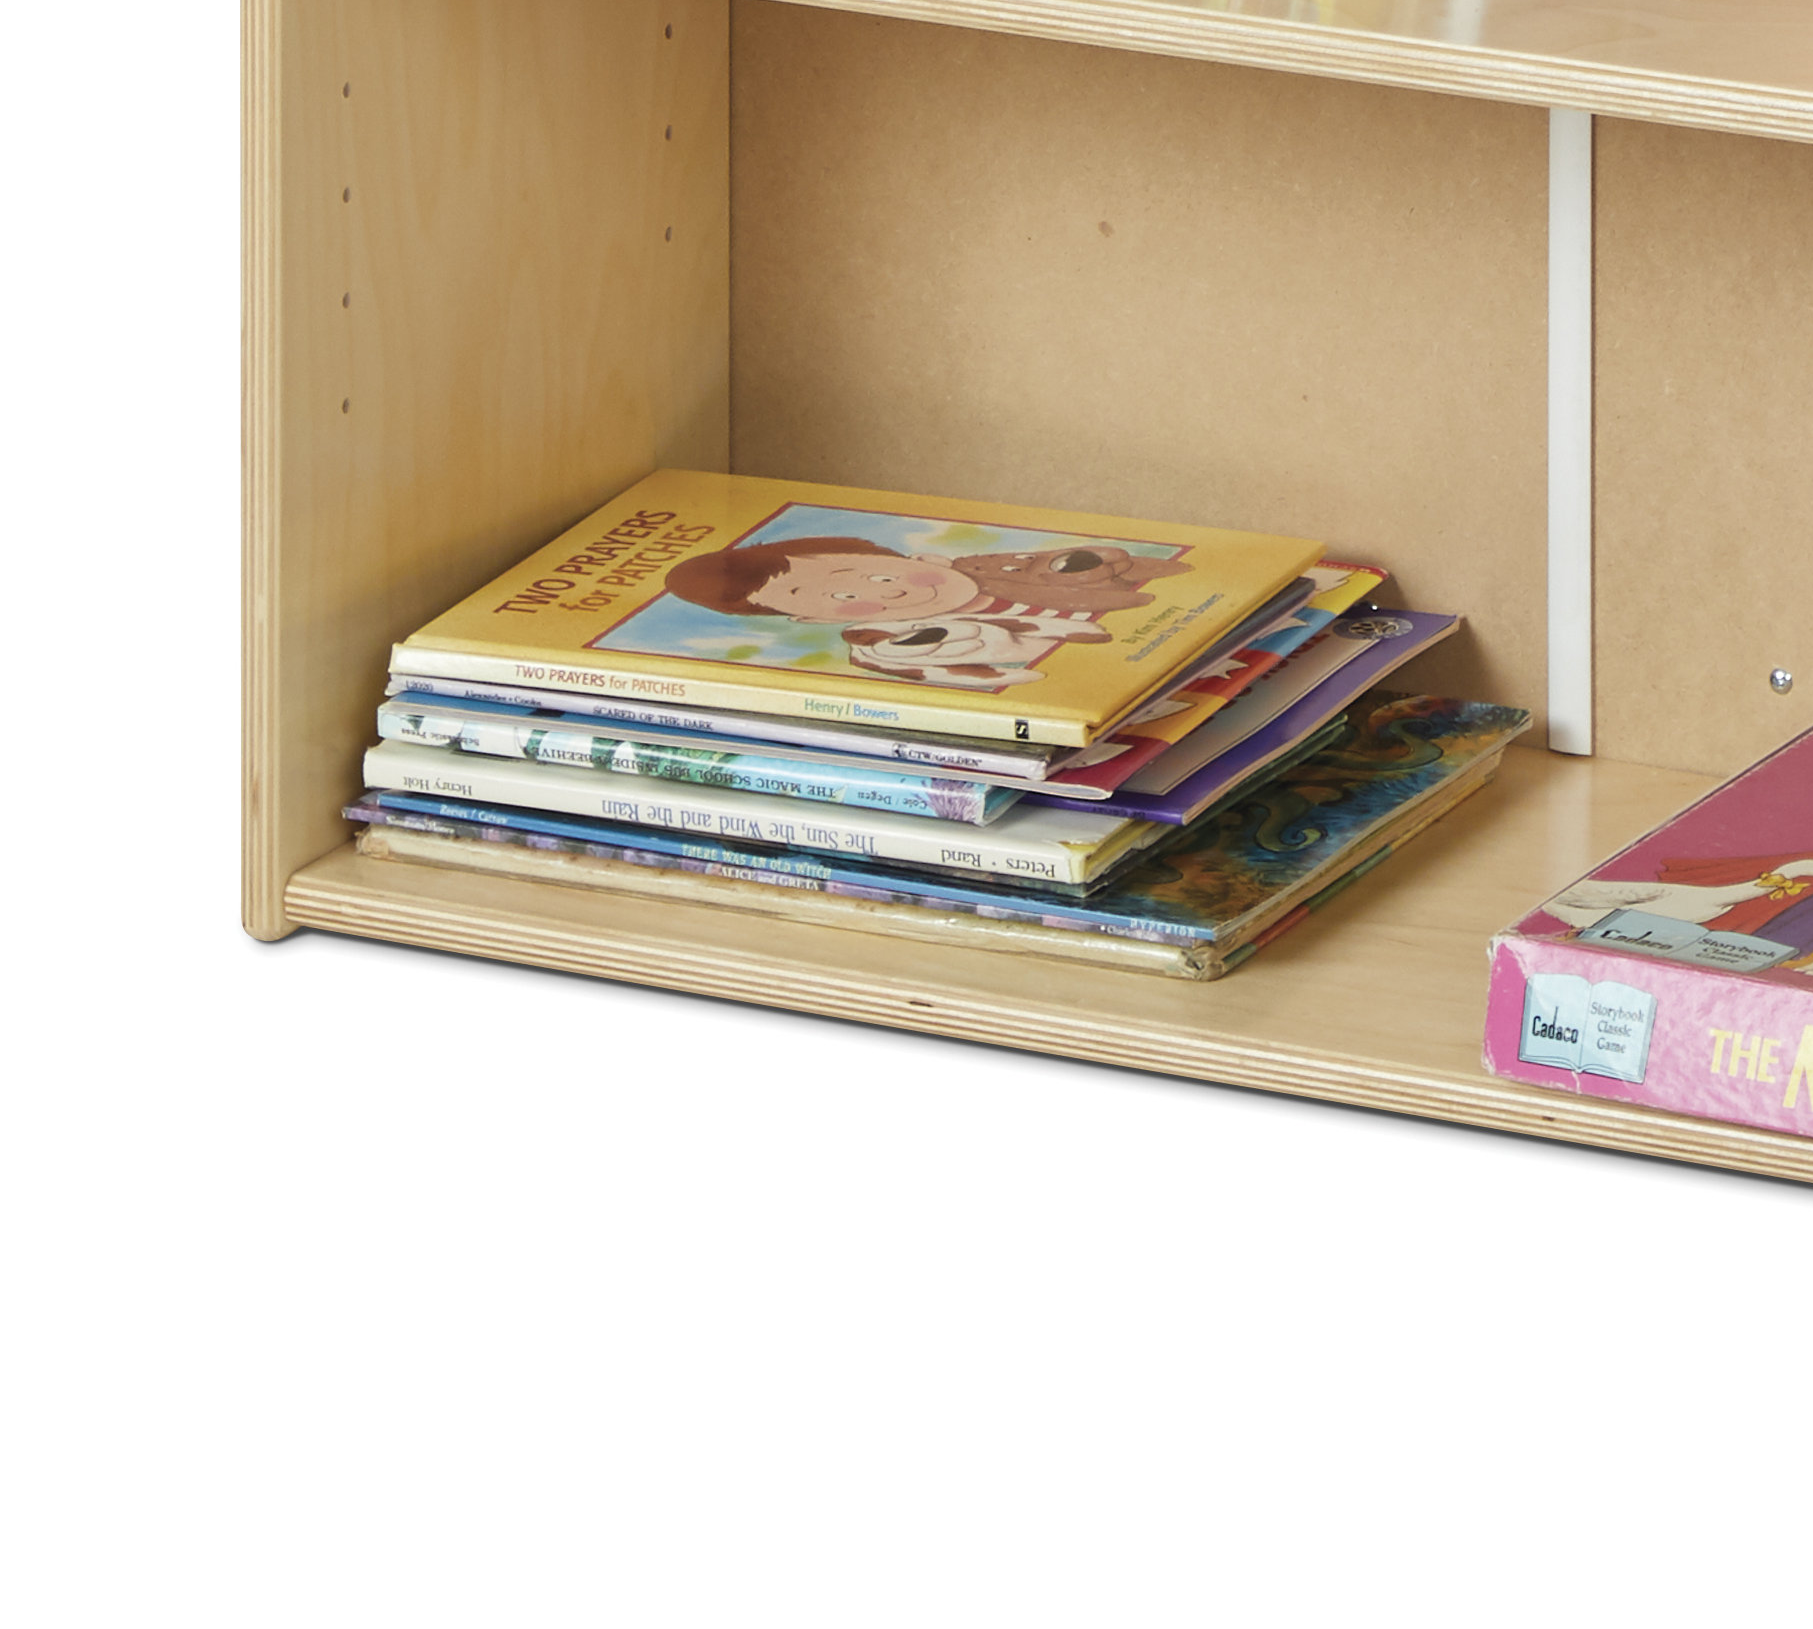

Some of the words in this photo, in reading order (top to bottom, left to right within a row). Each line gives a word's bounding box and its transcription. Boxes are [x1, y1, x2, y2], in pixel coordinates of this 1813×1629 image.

[494, 579, 575, 615] TWO
[555, 510, 679, 576] PRAYERS
[560, 587, 618, 615] for
[607, 524, 717, 589] PATCHES
[515, 665, 545, 680] TWO
[549, 669, 605, 687] PRAYERS
[609, 675, 627, 689] for
[631, 678, 686, 696] PATCHES
[602, 799, 639, 820] Rain
[648, 803, 675, 824] the
[680, 809, 712, 830] and
[716, 815, 763, 838] Wind
[768, 823, 795, 845] the
[844, 832, 877, 855] The
[1532, 1006, 1579, 1044] Cadaco
[1710, 1028, 1783, 1085] THE
